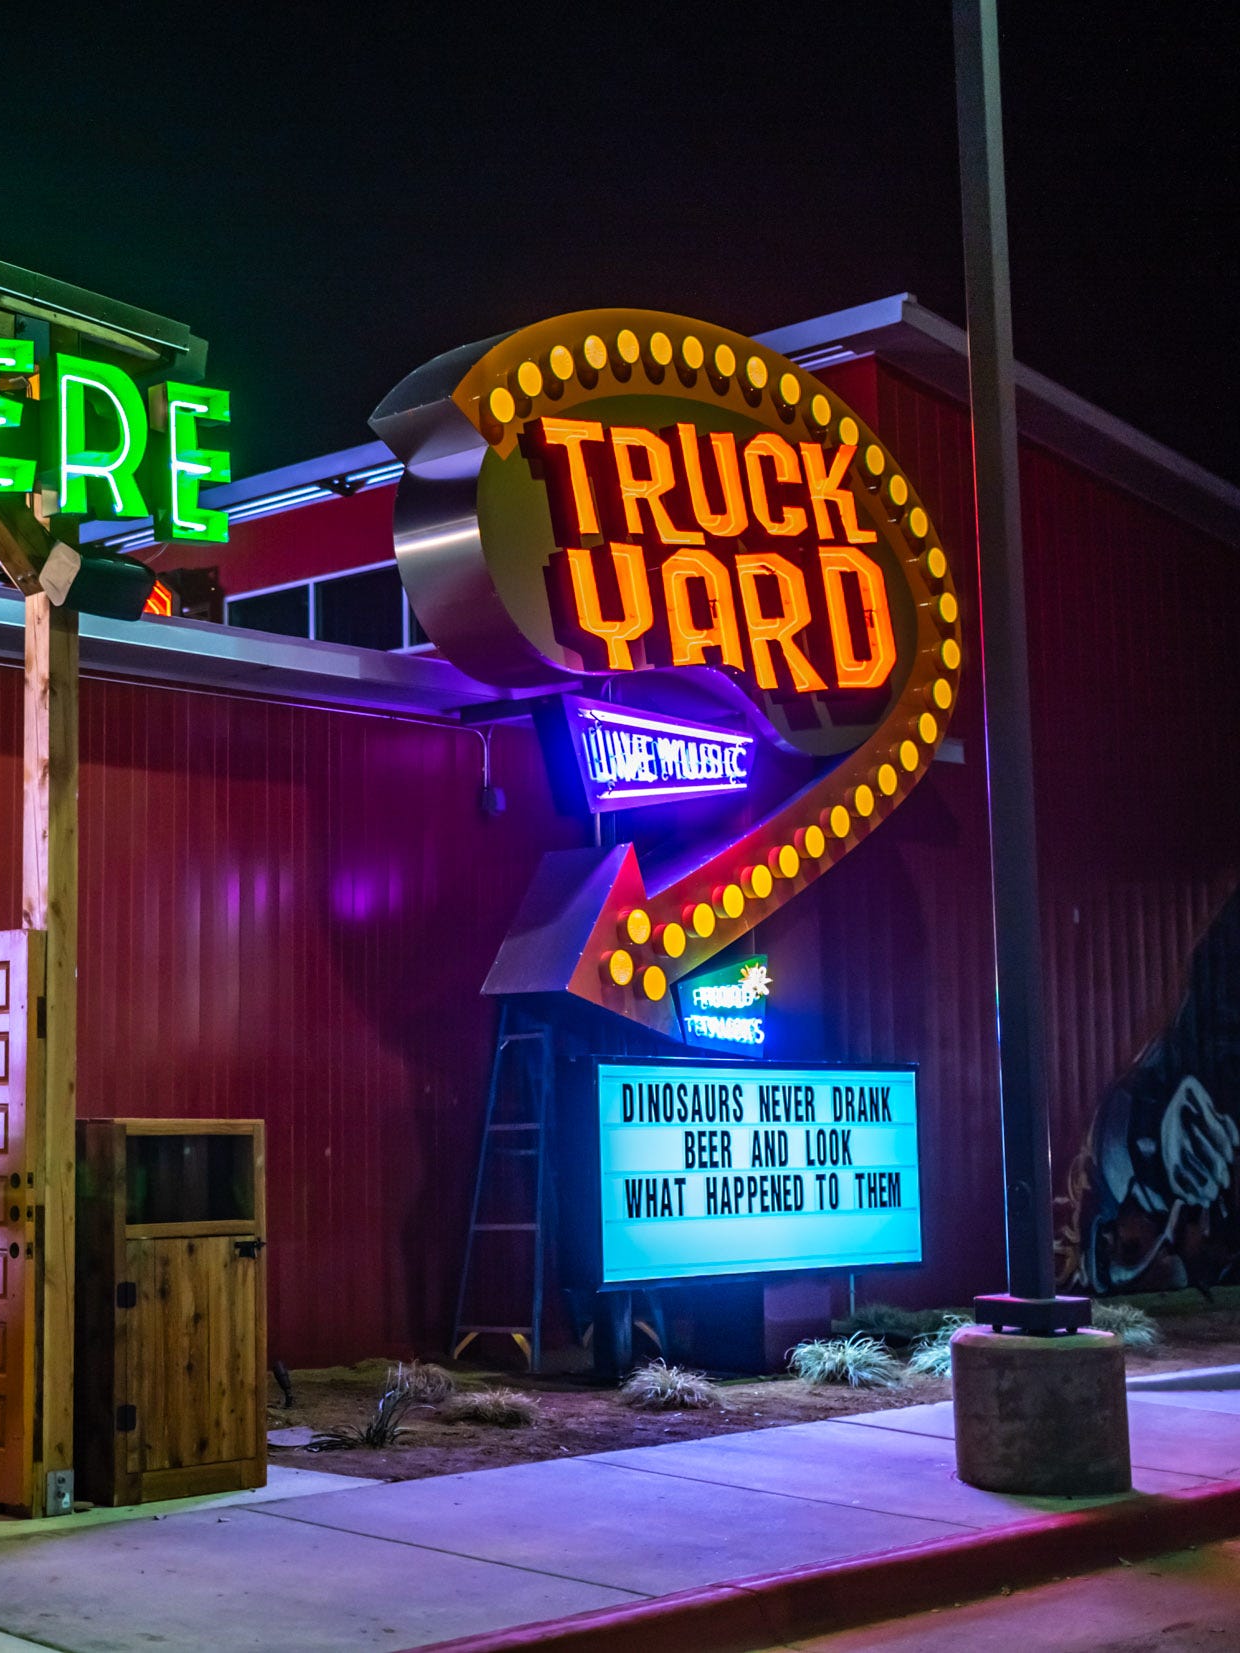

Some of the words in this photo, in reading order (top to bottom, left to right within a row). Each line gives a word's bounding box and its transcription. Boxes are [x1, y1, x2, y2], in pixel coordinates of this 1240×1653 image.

[539, 417, 877, 545] TRUCK
[566, 543, 896, 692] YARD
[621, 1083, 744, 1123] DINOSAURS
[759, 1084, 816, 1123] NEVER
[833, 1086, 892, 1123] DRANK
[684, 1130, 732, 1169] BEER
[751, 1129, 789, 1168] AND
[806, 1128, 853, 1166] LOOK
[625, 1177, 686, 1219] WHAT
[706, 1174, 804, 1216] HAPPENED
[815, 1173, 839, 1210] TO
[855, 1171, 902, 1209] THEM
